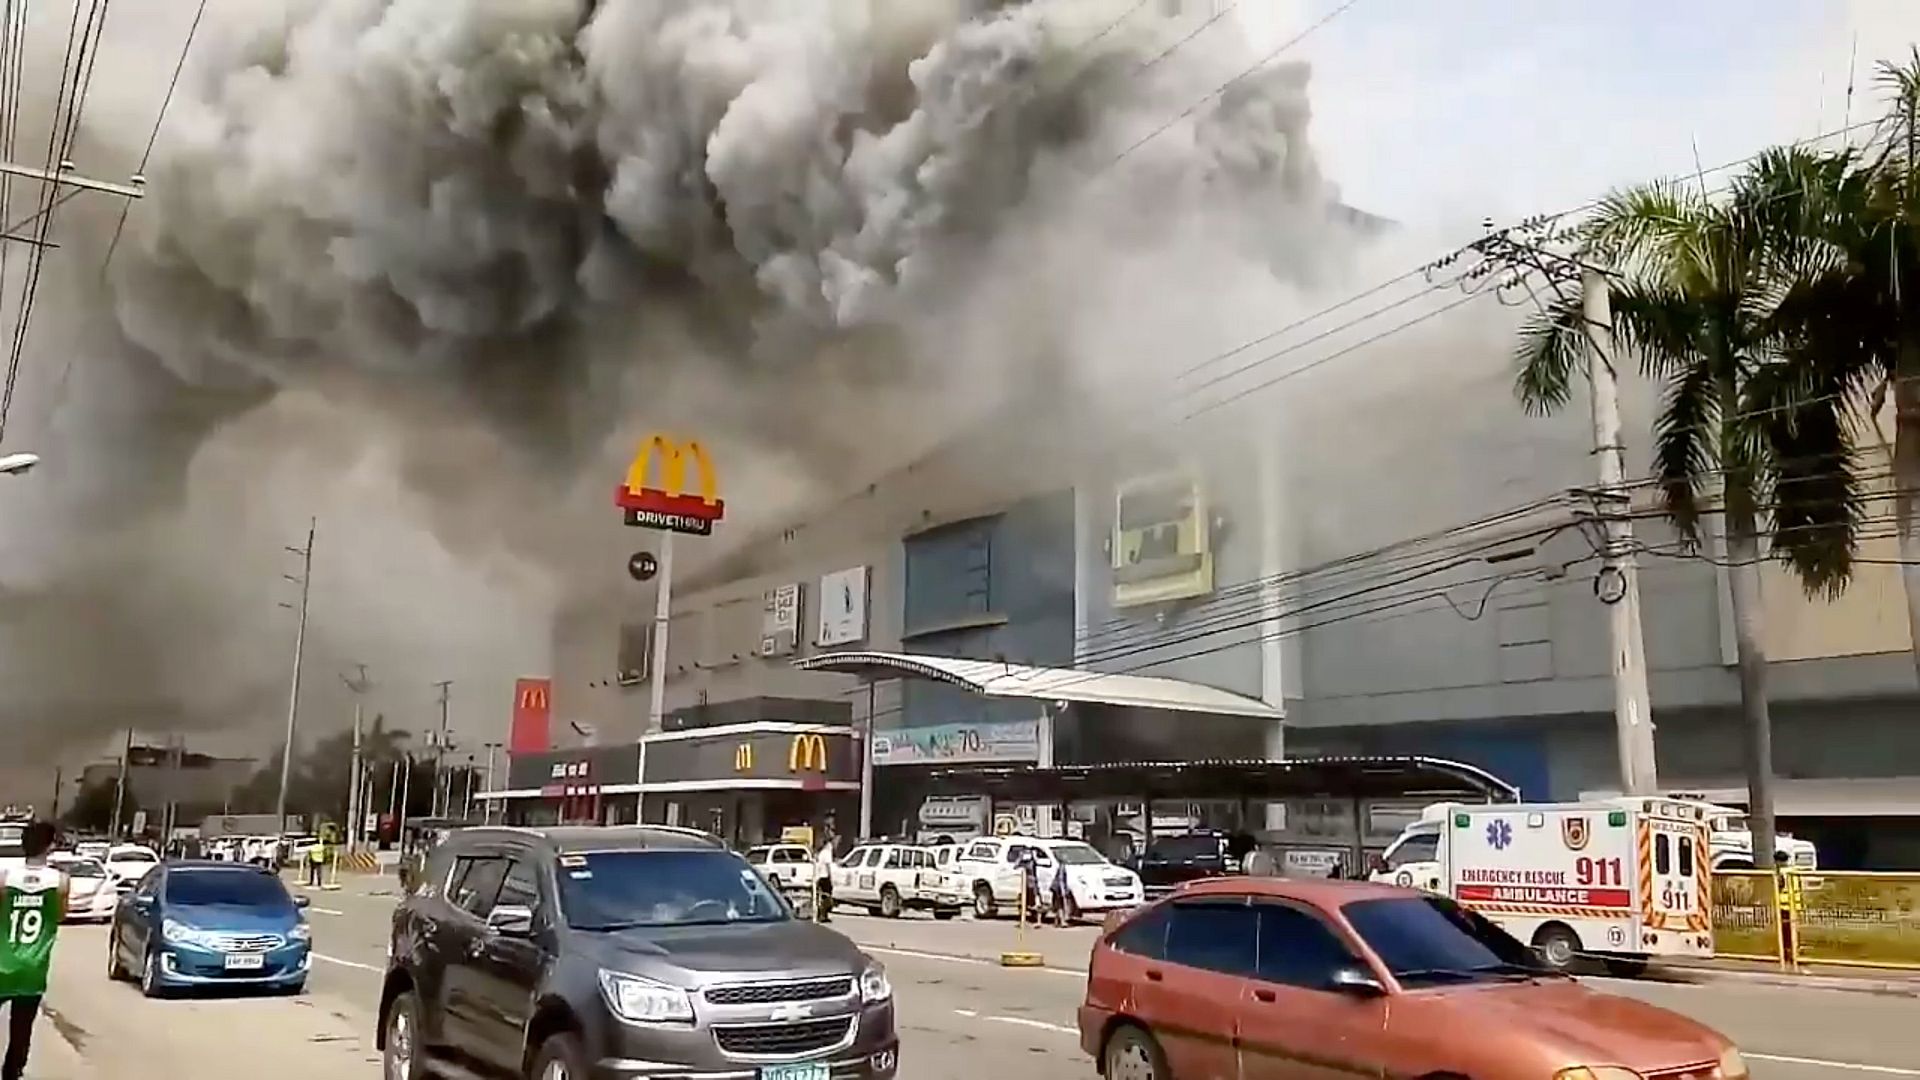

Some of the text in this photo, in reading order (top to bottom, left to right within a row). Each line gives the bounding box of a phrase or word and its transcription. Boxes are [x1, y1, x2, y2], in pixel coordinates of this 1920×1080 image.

[1462, 857, 1622, 886] EMERGENCY RESCUE 911
[1491, 887, 1590, 903] AMBULANCE
[1662, 889, 1689, 911] 911
[9, 909, 43, 944] 19
